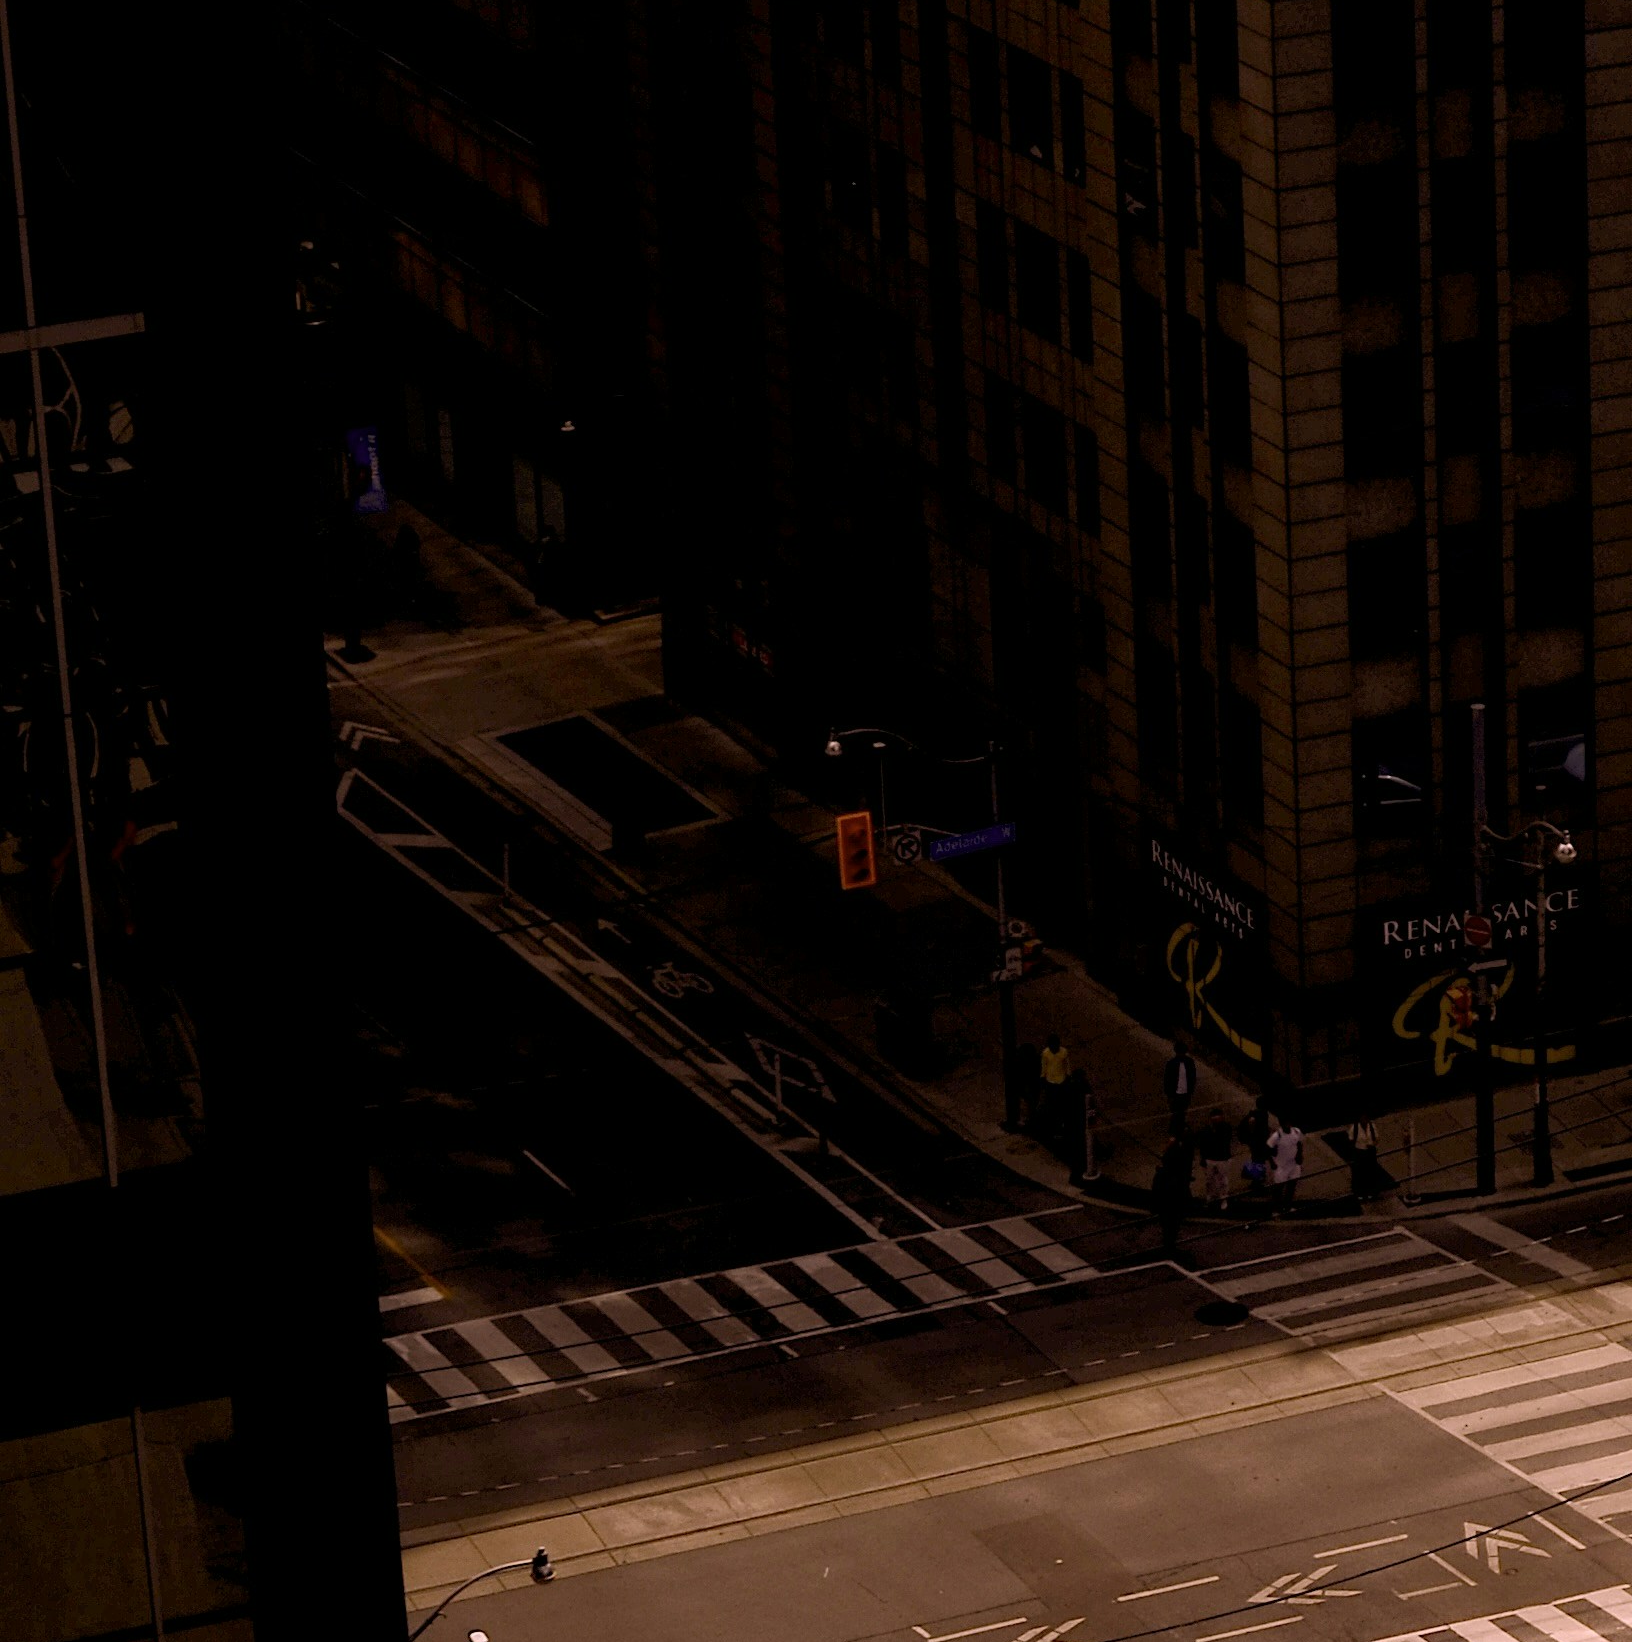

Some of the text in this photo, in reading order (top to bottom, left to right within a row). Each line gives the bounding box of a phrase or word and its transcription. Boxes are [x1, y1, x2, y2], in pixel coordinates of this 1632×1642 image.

[936, 833, 988, 854] Adelaide
[1151, 839, 1256, 930] RENAISSANCE
[1382, 888, 1581, 946] RENASANCE
[1503, 918, 1559, 940] ARS
